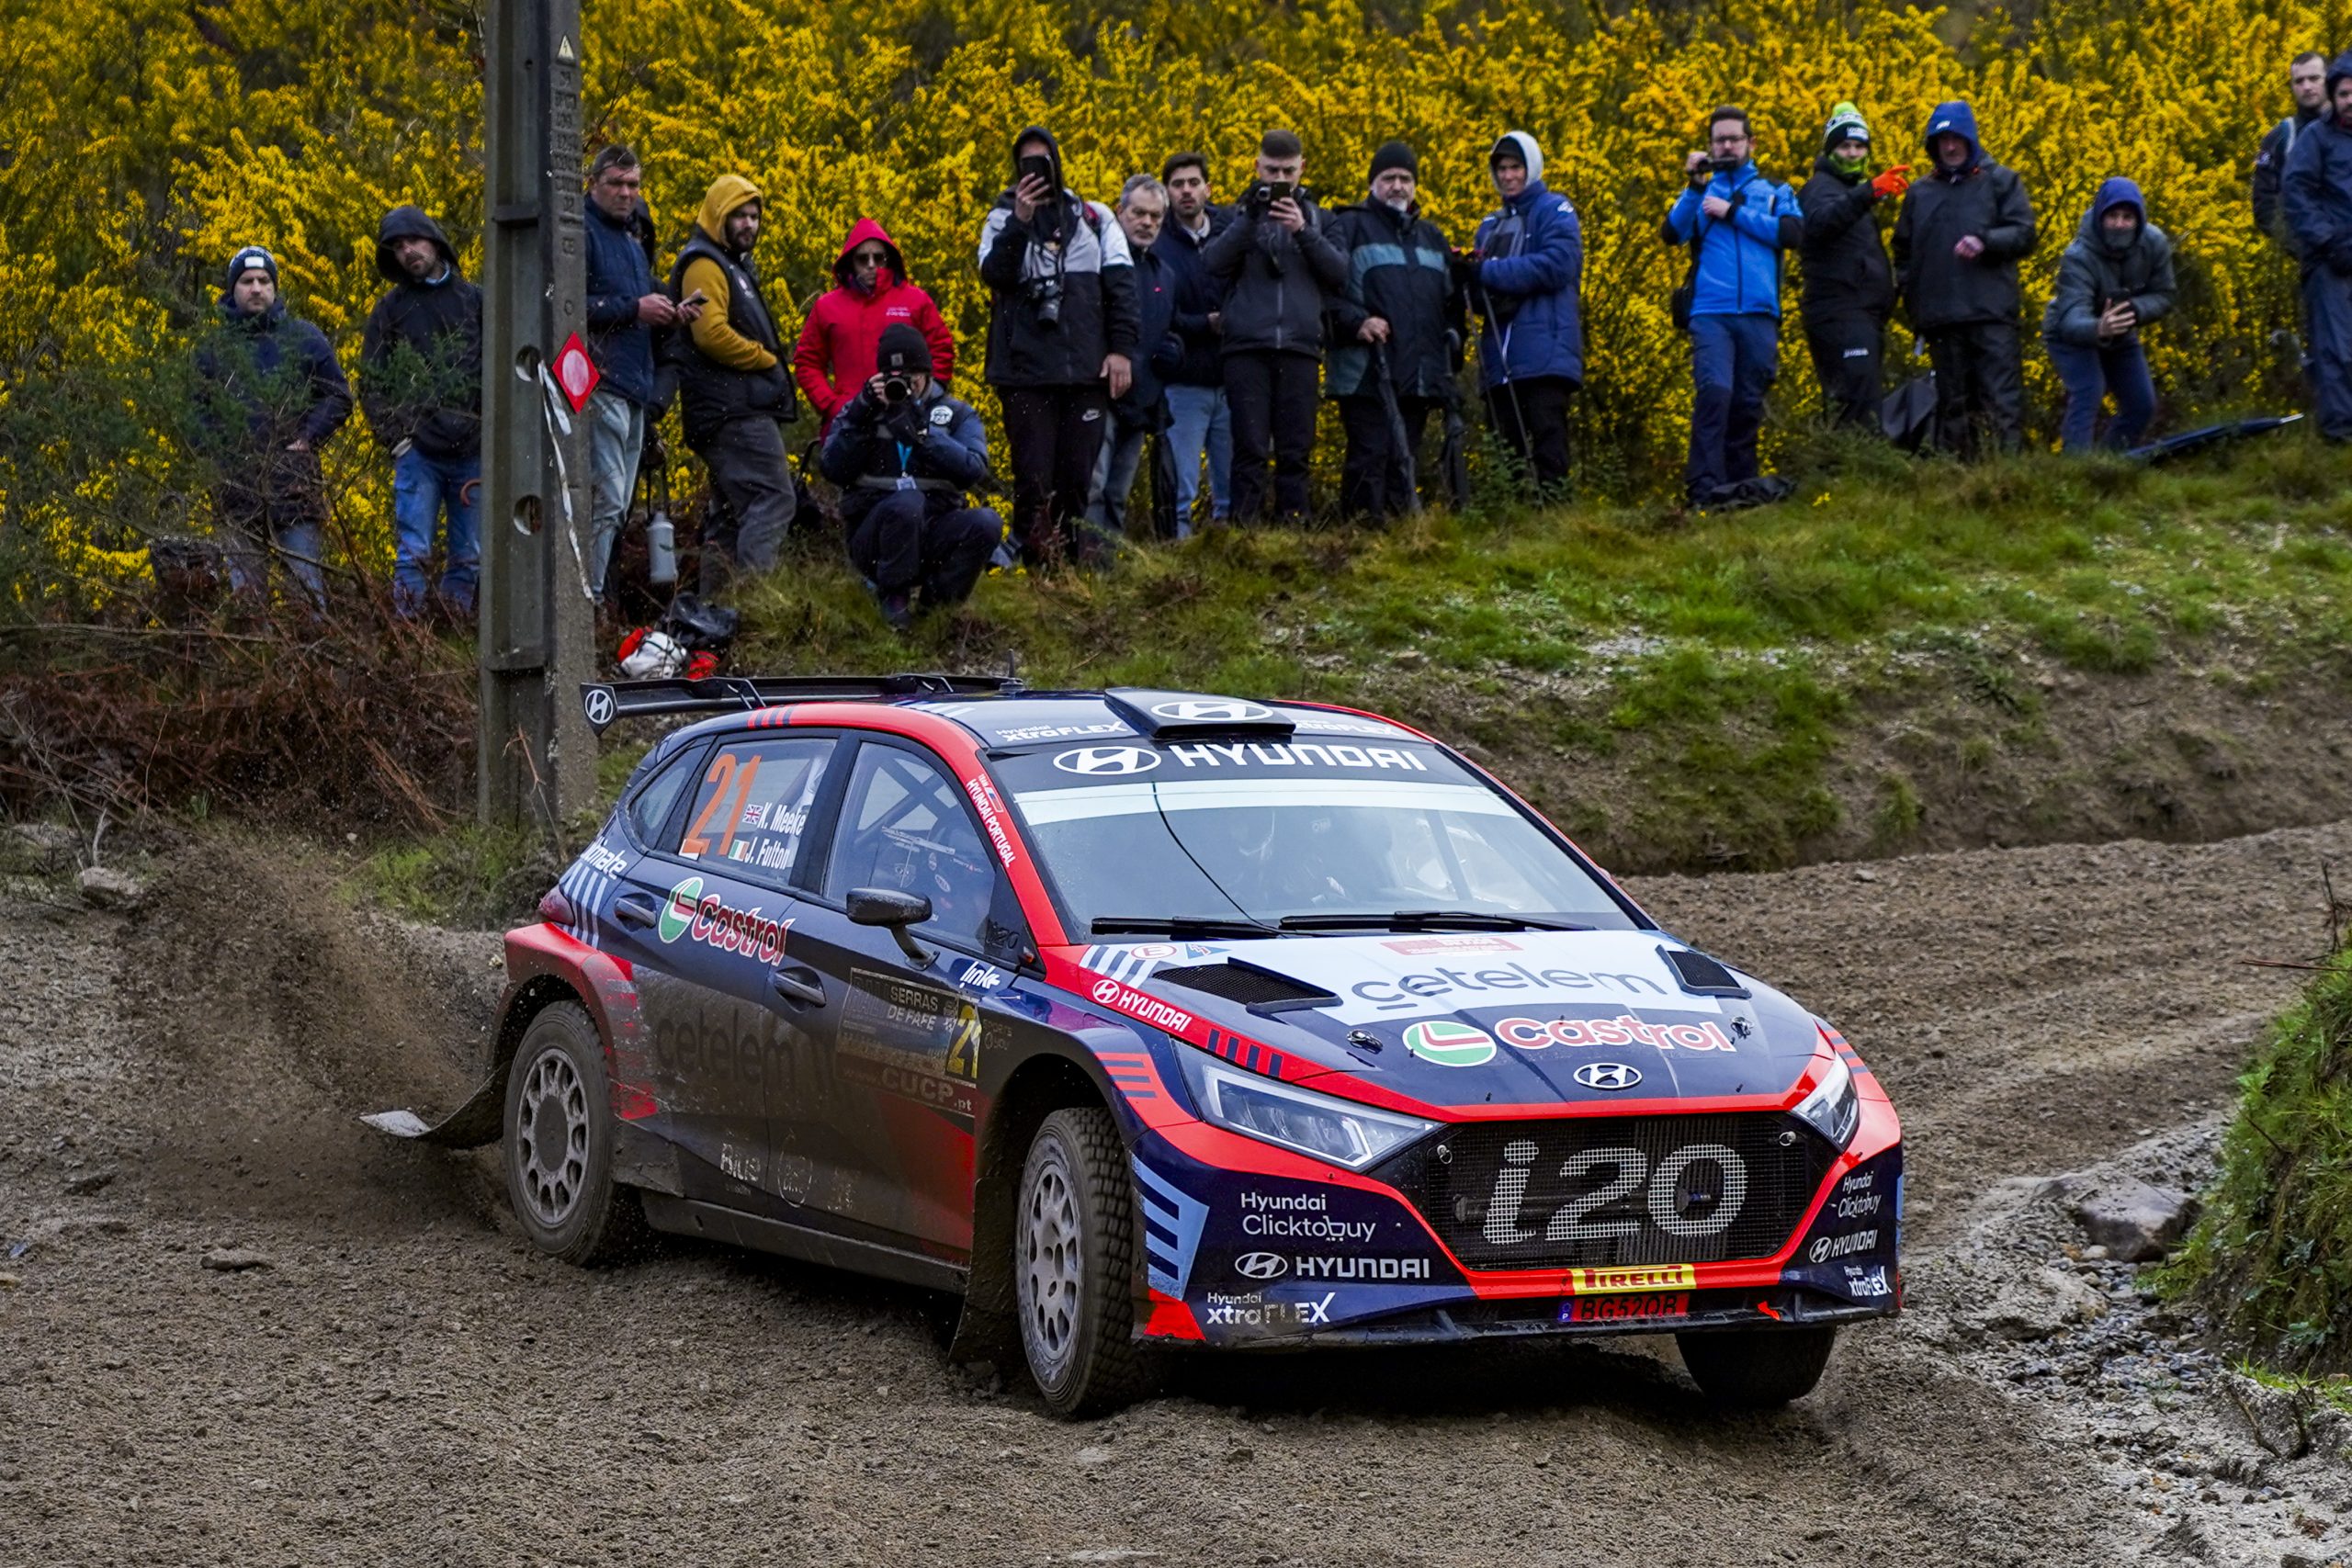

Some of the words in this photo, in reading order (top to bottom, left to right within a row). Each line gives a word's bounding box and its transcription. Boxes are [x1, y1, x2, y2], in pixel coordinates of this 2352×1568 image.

[995, 725, 1052, 735] Hyundai
[1001, 720, 1128, 742] xtraFLEX
[1169, 743, 1428, 772] HYUNDAI
[682, 753, 762, 856] 21
[757, 802, 769, 829] K.
[770, 804, 807, 836] Meeke
[967, 778, 994, 820] HYUNDAI
[985, 816, 1016, 868] PORTUGAL
[745, 837, 756, 864] J.
[755, 838, 791, 870] Fulton
[691, 894, 796, 966] Castrol
[889, 985, 939, 1011] SERRAS
[1351, 962, 1668, 1010] cetelem
[887, 1005, 904, 1022] DE
[905, 1010, 937, 1031] FAFE
[1118, 990, 1192, 1032] HYUNDAI
[1494, 1015, 1737, 1053] Castrol
[1483, 1139, 1748, 1244] i20
[1842, 1171, 1874, 1194] Hyundai
[1240, 1192, 1326, 1212] Hyundai
[1242, 1213, 1376, 1242] Clicktobuy
[1831, 1229, 1879, 1258] HYUNDAI
[1296, 1256, 1430, 1279] HYUNDAI
[1584, 1265, 1684, 1288] PIRELLI
[1848, 1266, 1894, 1297] xtraFLEX
[1206, 1292, 1262, 1305] Hyundai
